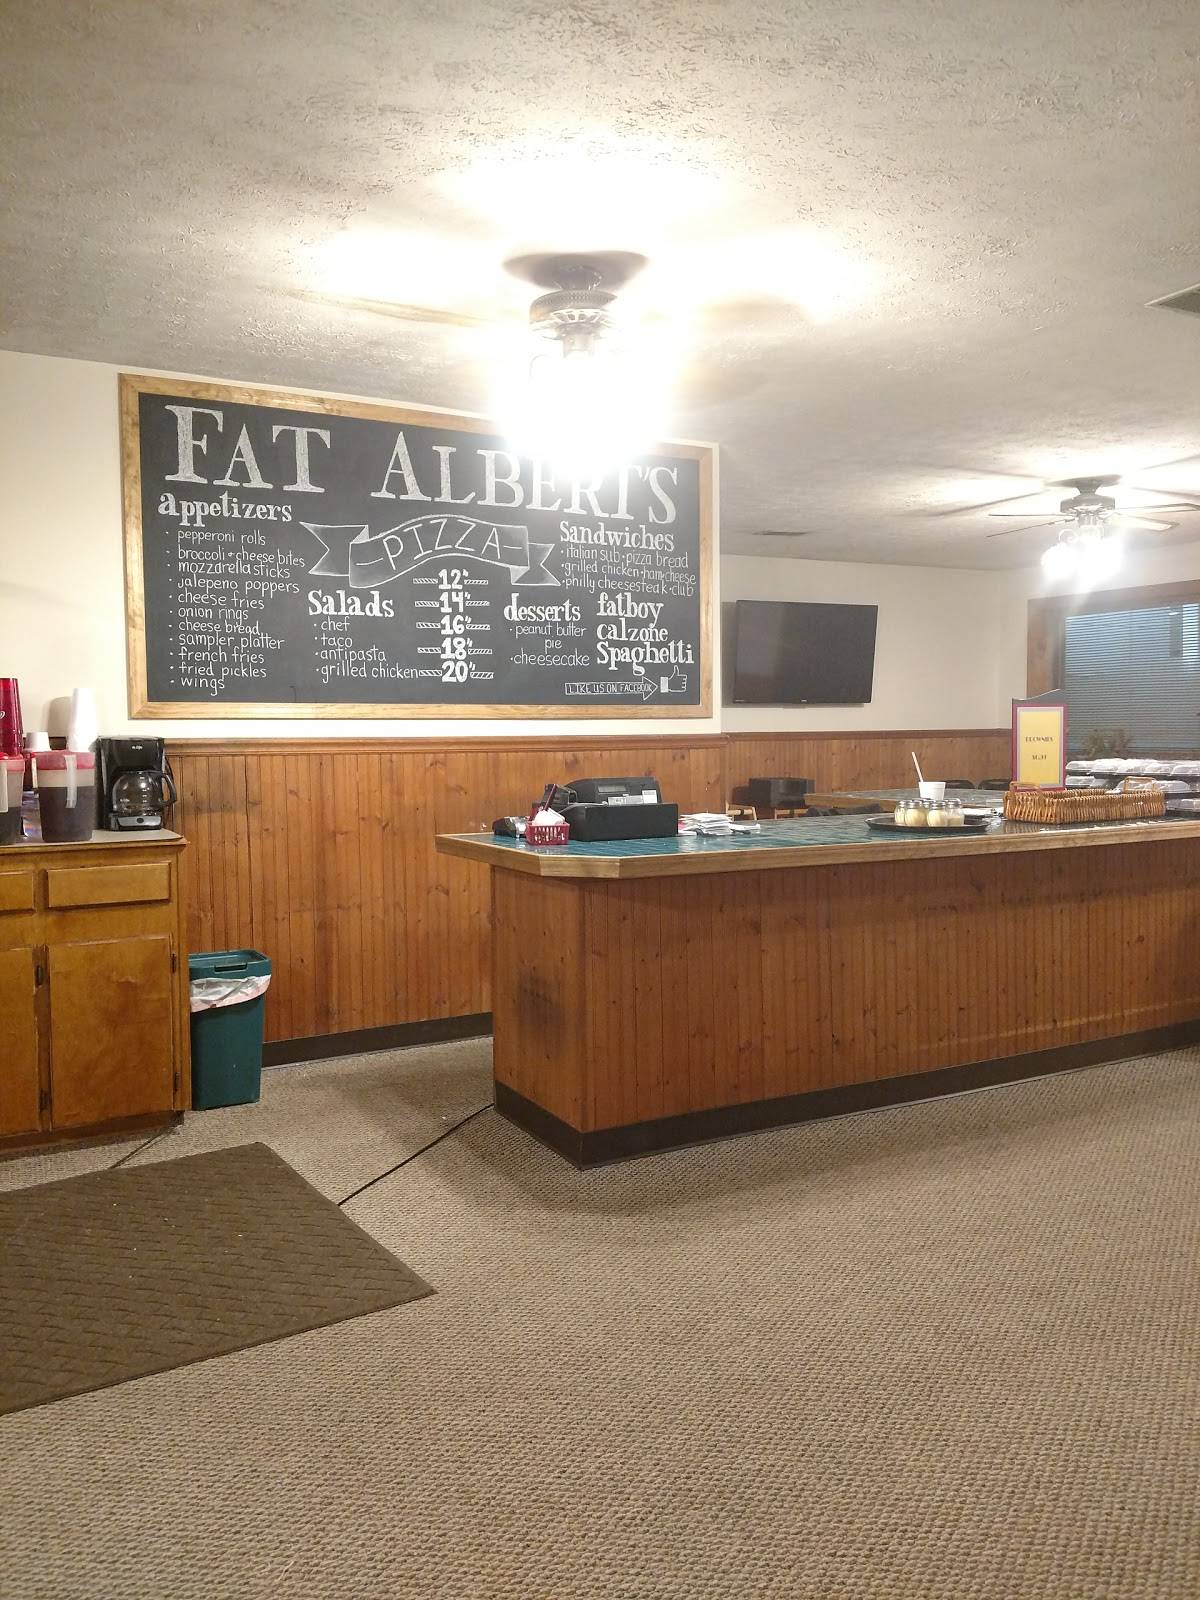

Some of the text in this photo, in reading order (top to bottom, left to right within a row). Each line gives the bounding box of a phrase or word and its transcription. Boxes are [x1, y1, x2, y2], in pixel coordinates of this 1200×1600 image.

[165, 404, 678, 524] FAT ALBERT'S
[158, 490, 292, 527] appetizers
[178, 529, 266, 545] pepperoni rolls
[383, 518, 501, 570] PIZZA
[559, 520, 675, 551] Sandwiches
[178, 544, 225, 560] broccoli
[236, 546, 275, 563] cheese
[277, 548, 305, 567] bites
[566, 544, 620, 562] italian sub
[626, 550, 688, 568] pizza bread
[178, 561, 290, 578] mozzarella sticks
[564, 559, 639, 577] grilled chicken
[665, 568, 696, 584] cheese
[178, 573, 299, 598] jalepeno poppers
[439, 568, 469, 590] 12"
[565, 573, 668, 594] philly cheesesteak
[671, 581, 693, 596] club
[178, 588, 264, 609] cheese fries
[308, 589, 395, 617] Salads
[439, 591, 471, 613] 14"
[504, 593, 581, 622] desserts
[178, 605, 248, 626] onion rings
[597, 591, 664, 628] fatboy
[179, 617, 260, 635] cheese bread
[321, 616, 350, 631] chef
[441, 615, 472, 635] 16"
[516, 623, 587, 638] peanut butter
[597, 618, 668, 642] calzone
[179, 632, 285, 650] sampler platter
[321, 633, 353, 647] taco
[440, 637, 473, 660] 18"
[544, 636, 562, 653] pie
[178, 646, 264, 663] french fries
[320, 645, 386, 667] antipasta
[514, 648, 590, 666] cheesecake
[597, 640, 694, 676] Spaghetti
[179, 661, 267, 680] fried pickles
[321, 660, 418, 683] grilled chicken
[442, 660, 476, 683] 20"
[181, 677, 225, 696] wings
[569, 683, 590, 693] LIKE
[593, 682, 605, 693] US
[606, 682, 617, 693] ON
